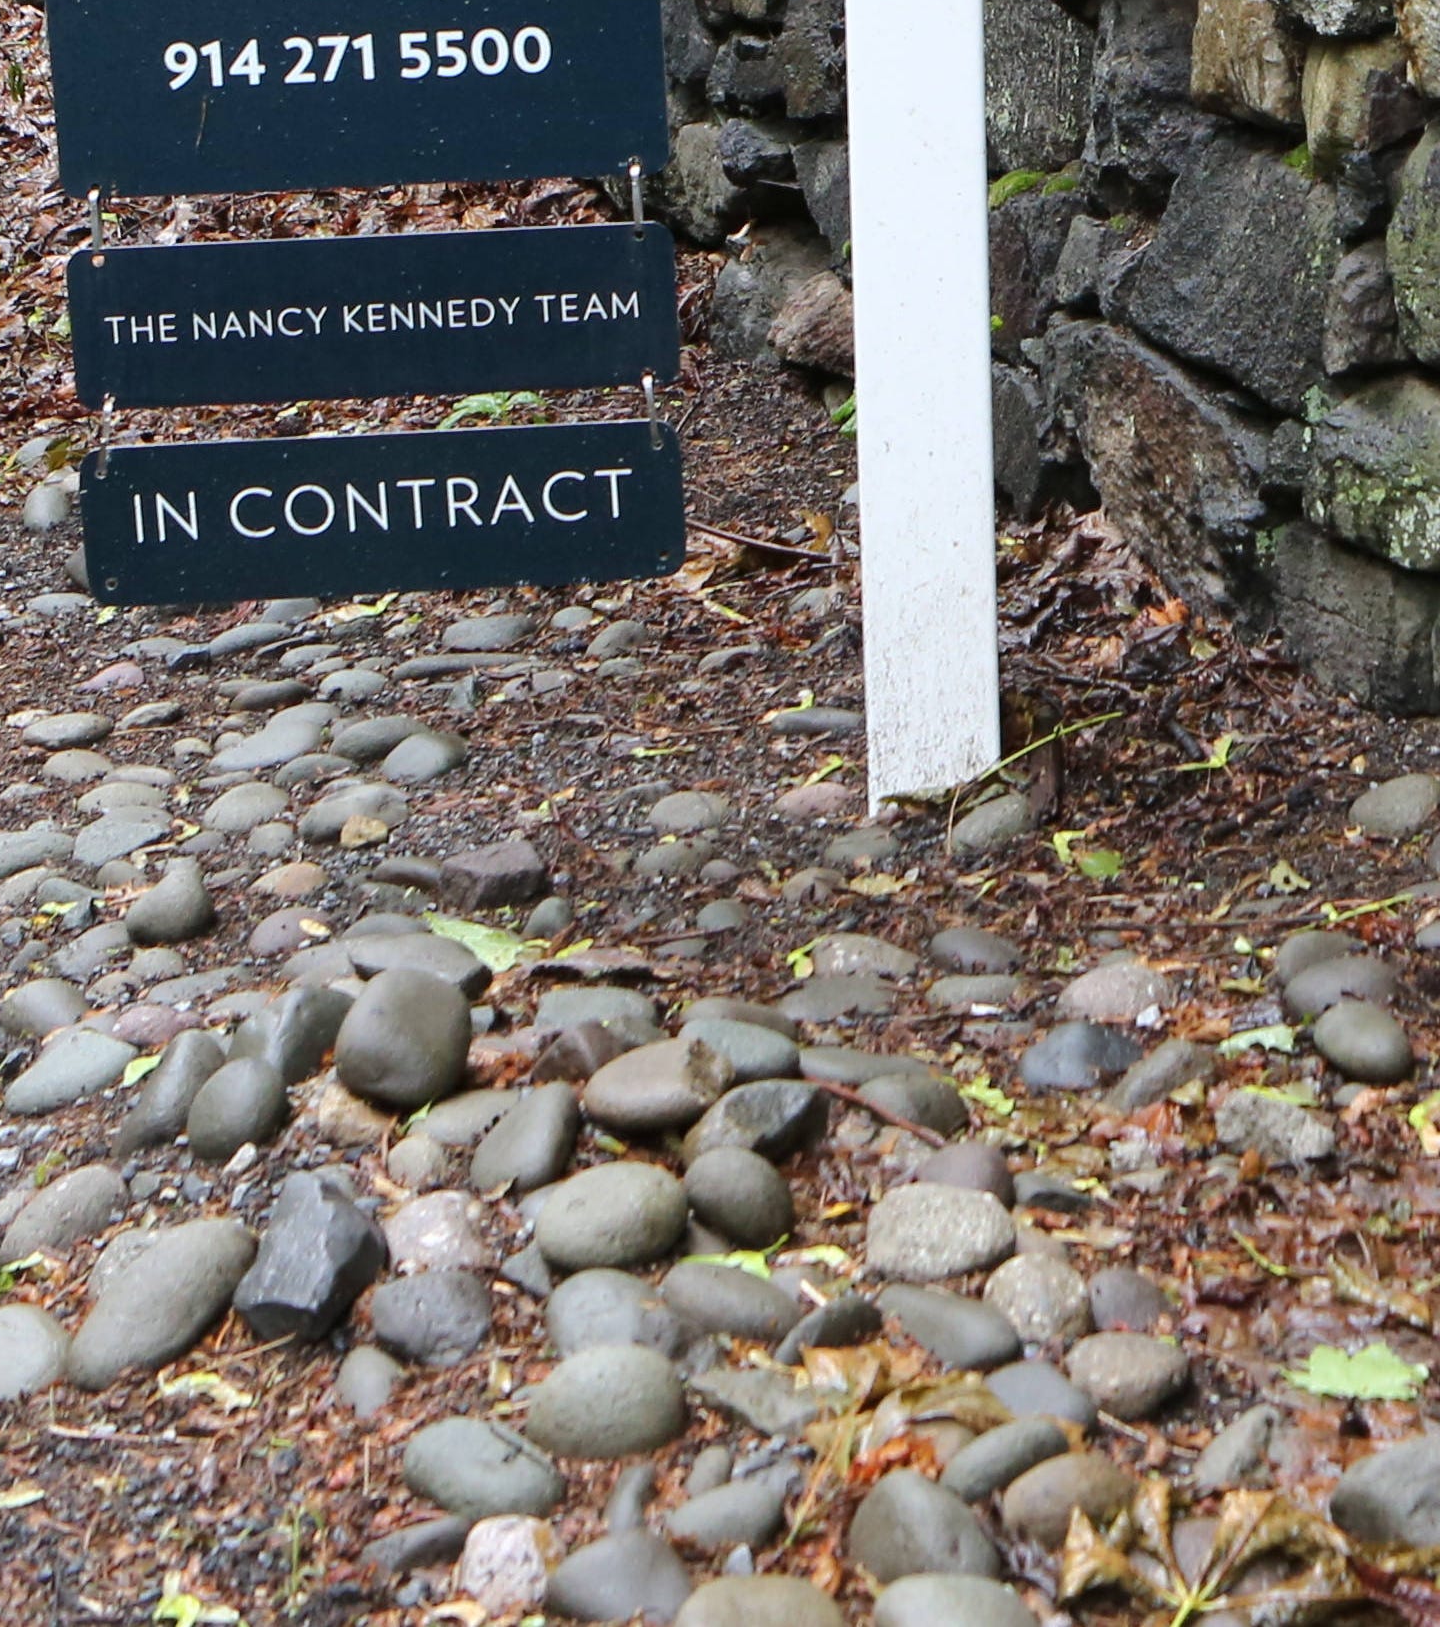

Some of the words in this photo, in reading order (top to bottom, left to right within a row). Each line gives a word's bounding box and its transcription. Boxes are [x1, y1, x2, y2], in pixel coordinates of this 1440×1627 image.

[163, 38, 266, 91] 914
[283, 33, 375, 84] 271
[399, 26, 552, 79] 5500
[103, 313, 178, 345] THE
[192, 306, 327, 341] NANCY
[342, 296, 520, 333] KENNEDY
[534, 291, 640, 323] TEAM
[133, 491, 199, 544] IN
[229, 468, 633, 538] CONTRACT
